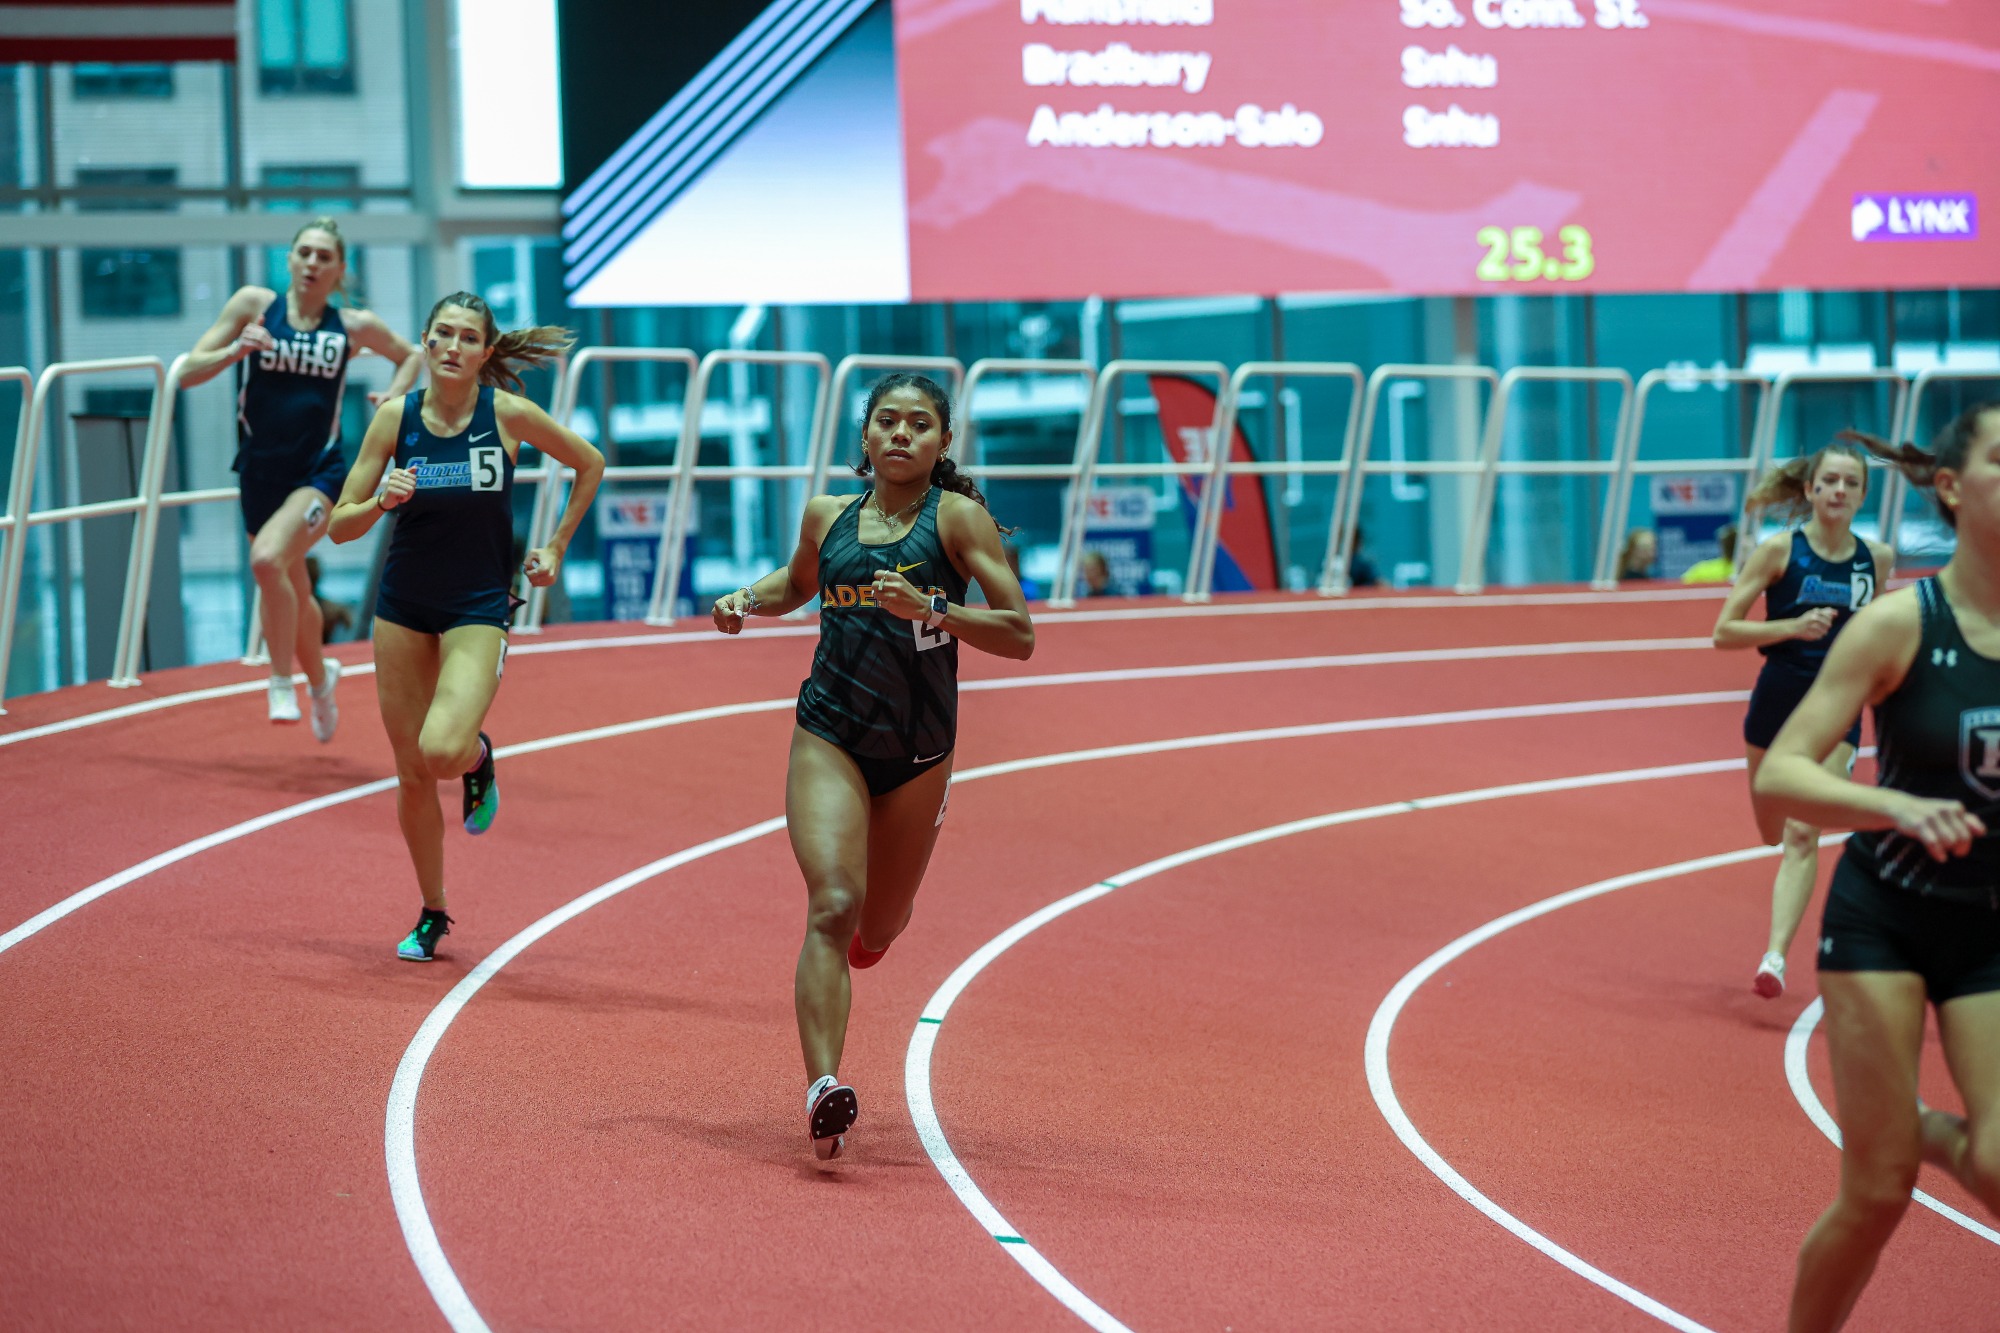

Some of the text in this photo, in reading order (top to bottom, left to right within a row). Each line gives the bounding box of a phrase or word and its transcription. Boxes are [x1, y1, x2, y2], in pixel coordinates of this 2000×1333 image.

[1022, 42, 1213, 93] Bradbury
[1400, 45, 1498, 88] Snhu
[1026, 103, 1324, 148] Anderson-Salo
[1402, 104, 1500, 148] Snhu
[1887, 197, 1970, 234] LYNX
[1475, 225, 1595, 282] 25.3
[323, 336, 337, 364] 6
[478, 449, 497, 488] 5
